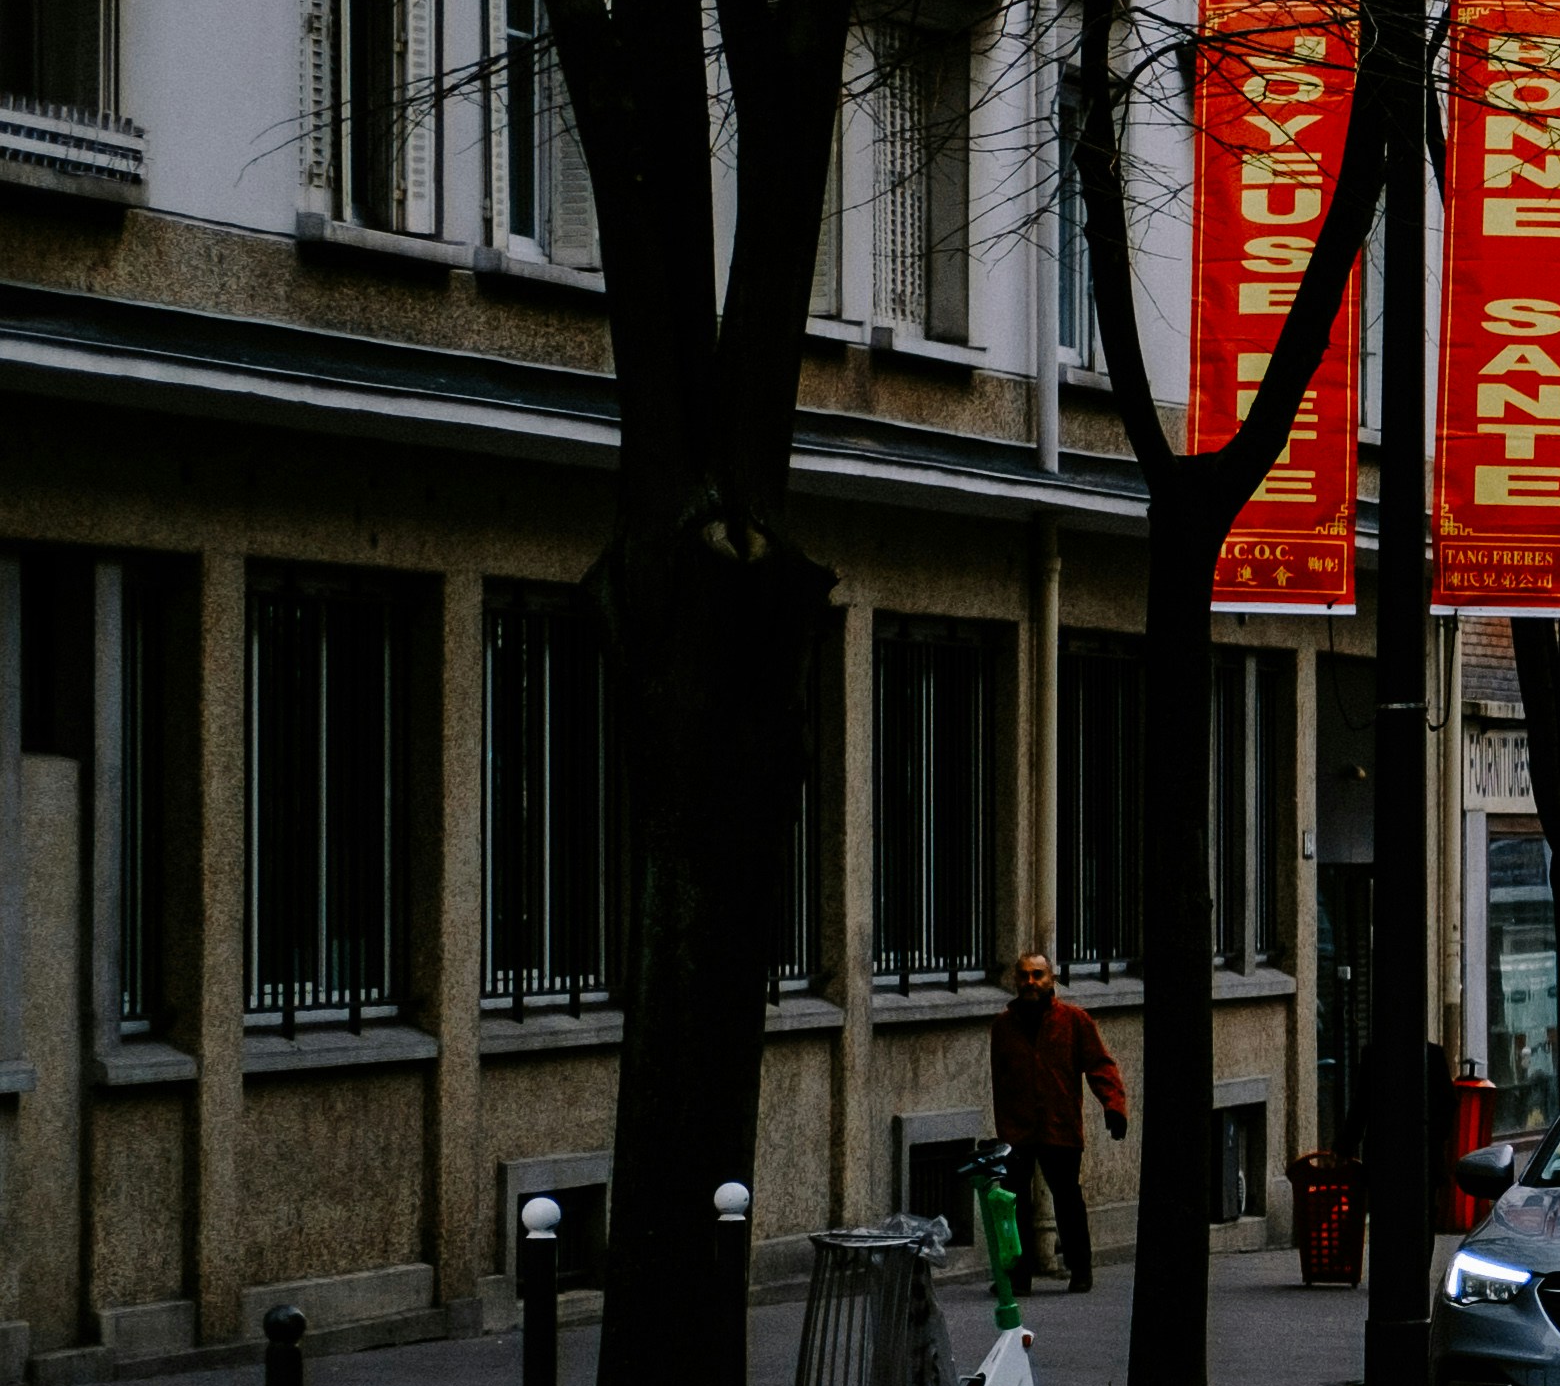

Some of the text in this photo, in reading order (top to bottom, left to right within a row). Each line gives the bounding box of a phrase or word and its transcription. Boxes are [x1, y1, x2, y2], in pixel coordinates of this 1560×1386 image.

[1238, 35, 1327, 316] JOYEUSE
[1446, 549, 1554, 566] TANG FRERES
